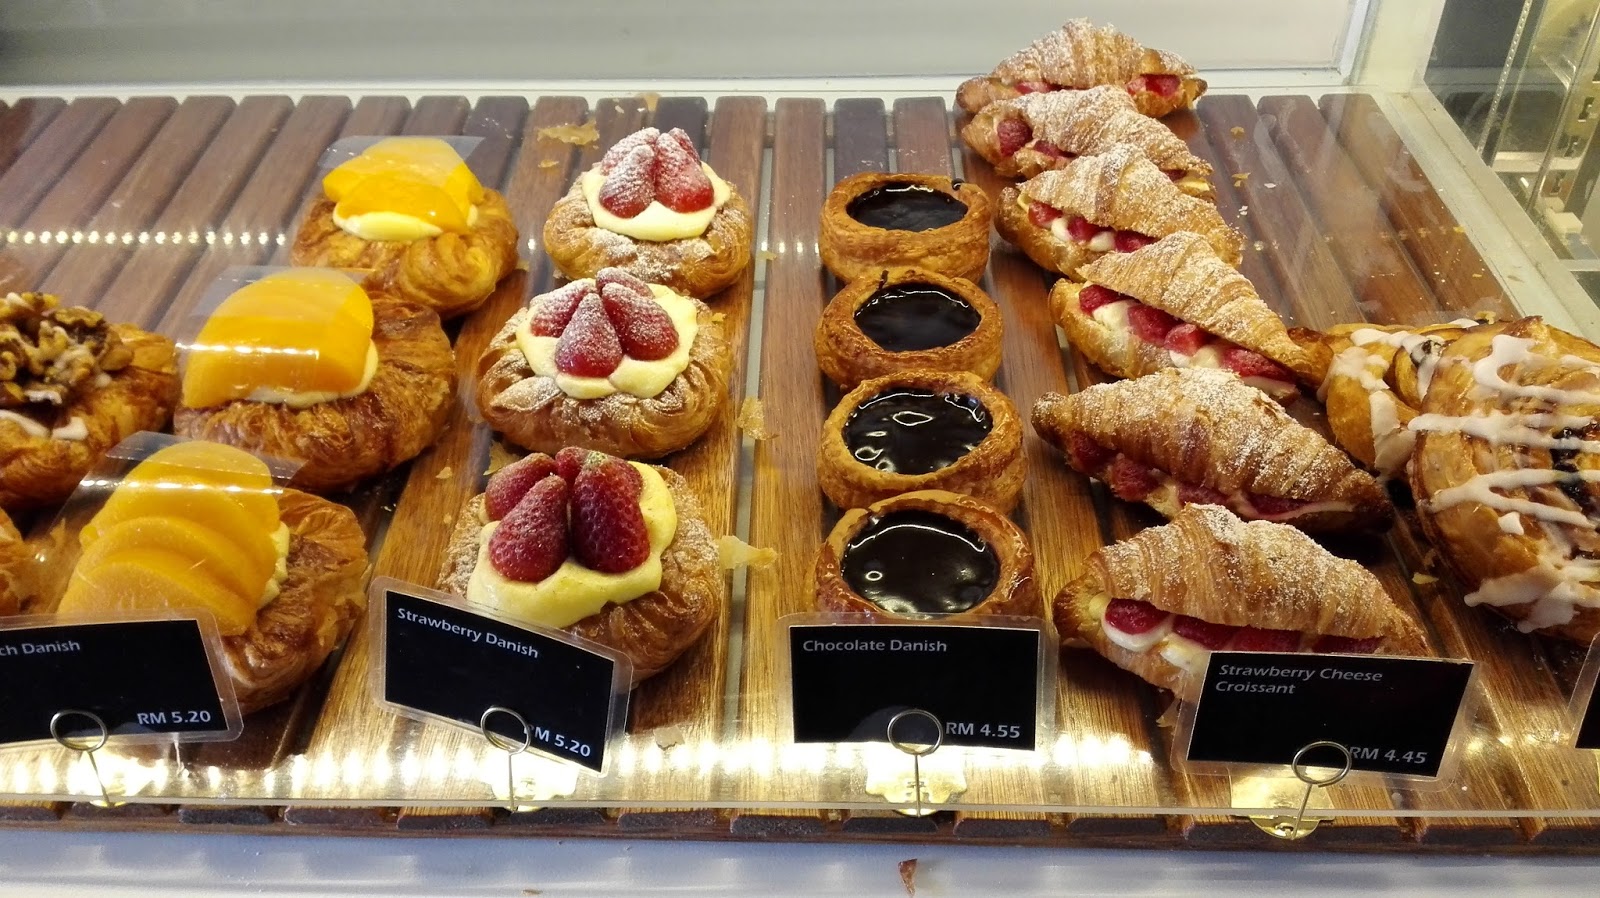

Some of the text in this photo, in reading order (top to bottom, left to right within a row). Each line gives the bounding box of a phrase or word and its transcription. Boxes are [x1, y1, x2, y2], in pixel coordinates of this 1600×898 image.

[396, 607, 539, 659] Strawberry Danish
[21, 640, 81, 655] Danish
[802, 639, 948, 652] Chocolate Danish
[1218, 664, 1384, 682] Strawberry Cheese
[1215, 680, 1297, 695] Croissant
[136, 710, 212, 725] RM 5.20
[945, 721, 1021, 739] RM 4.55
[554, 733, 592, 757] 5.20
[1348, 746, 1428, 764] RM 4.45
